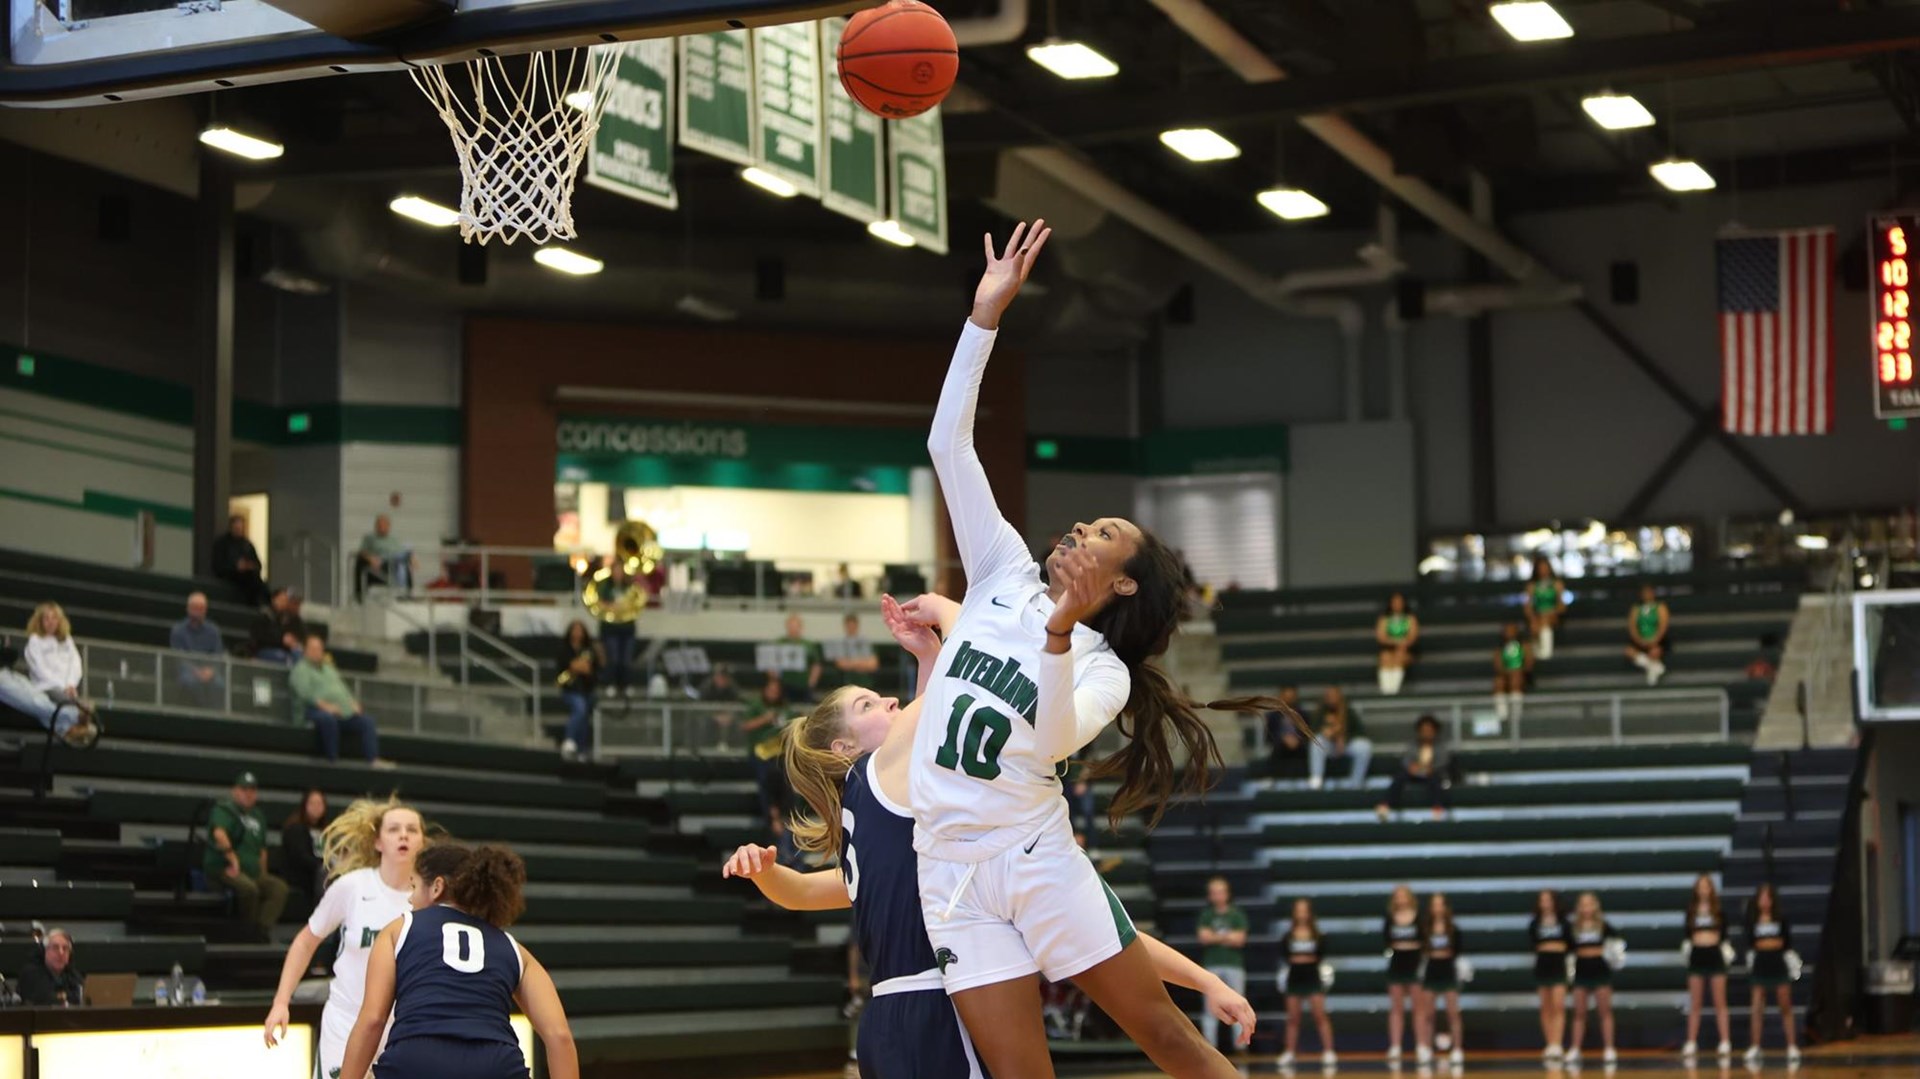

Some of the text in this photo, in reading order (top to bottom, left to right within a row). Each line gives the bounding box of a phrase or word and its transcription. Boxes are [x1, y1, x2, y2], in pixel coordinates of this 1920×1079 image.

[1882, 258, 1909, 287] 10
[1883, 289, 1909, 318] 12
[1878, 320, 1911, 351] 22
[555, 420, 747, 457] concessions
[935, 693, 1012, 781] 10
[442, 922, 485, 973] 0
